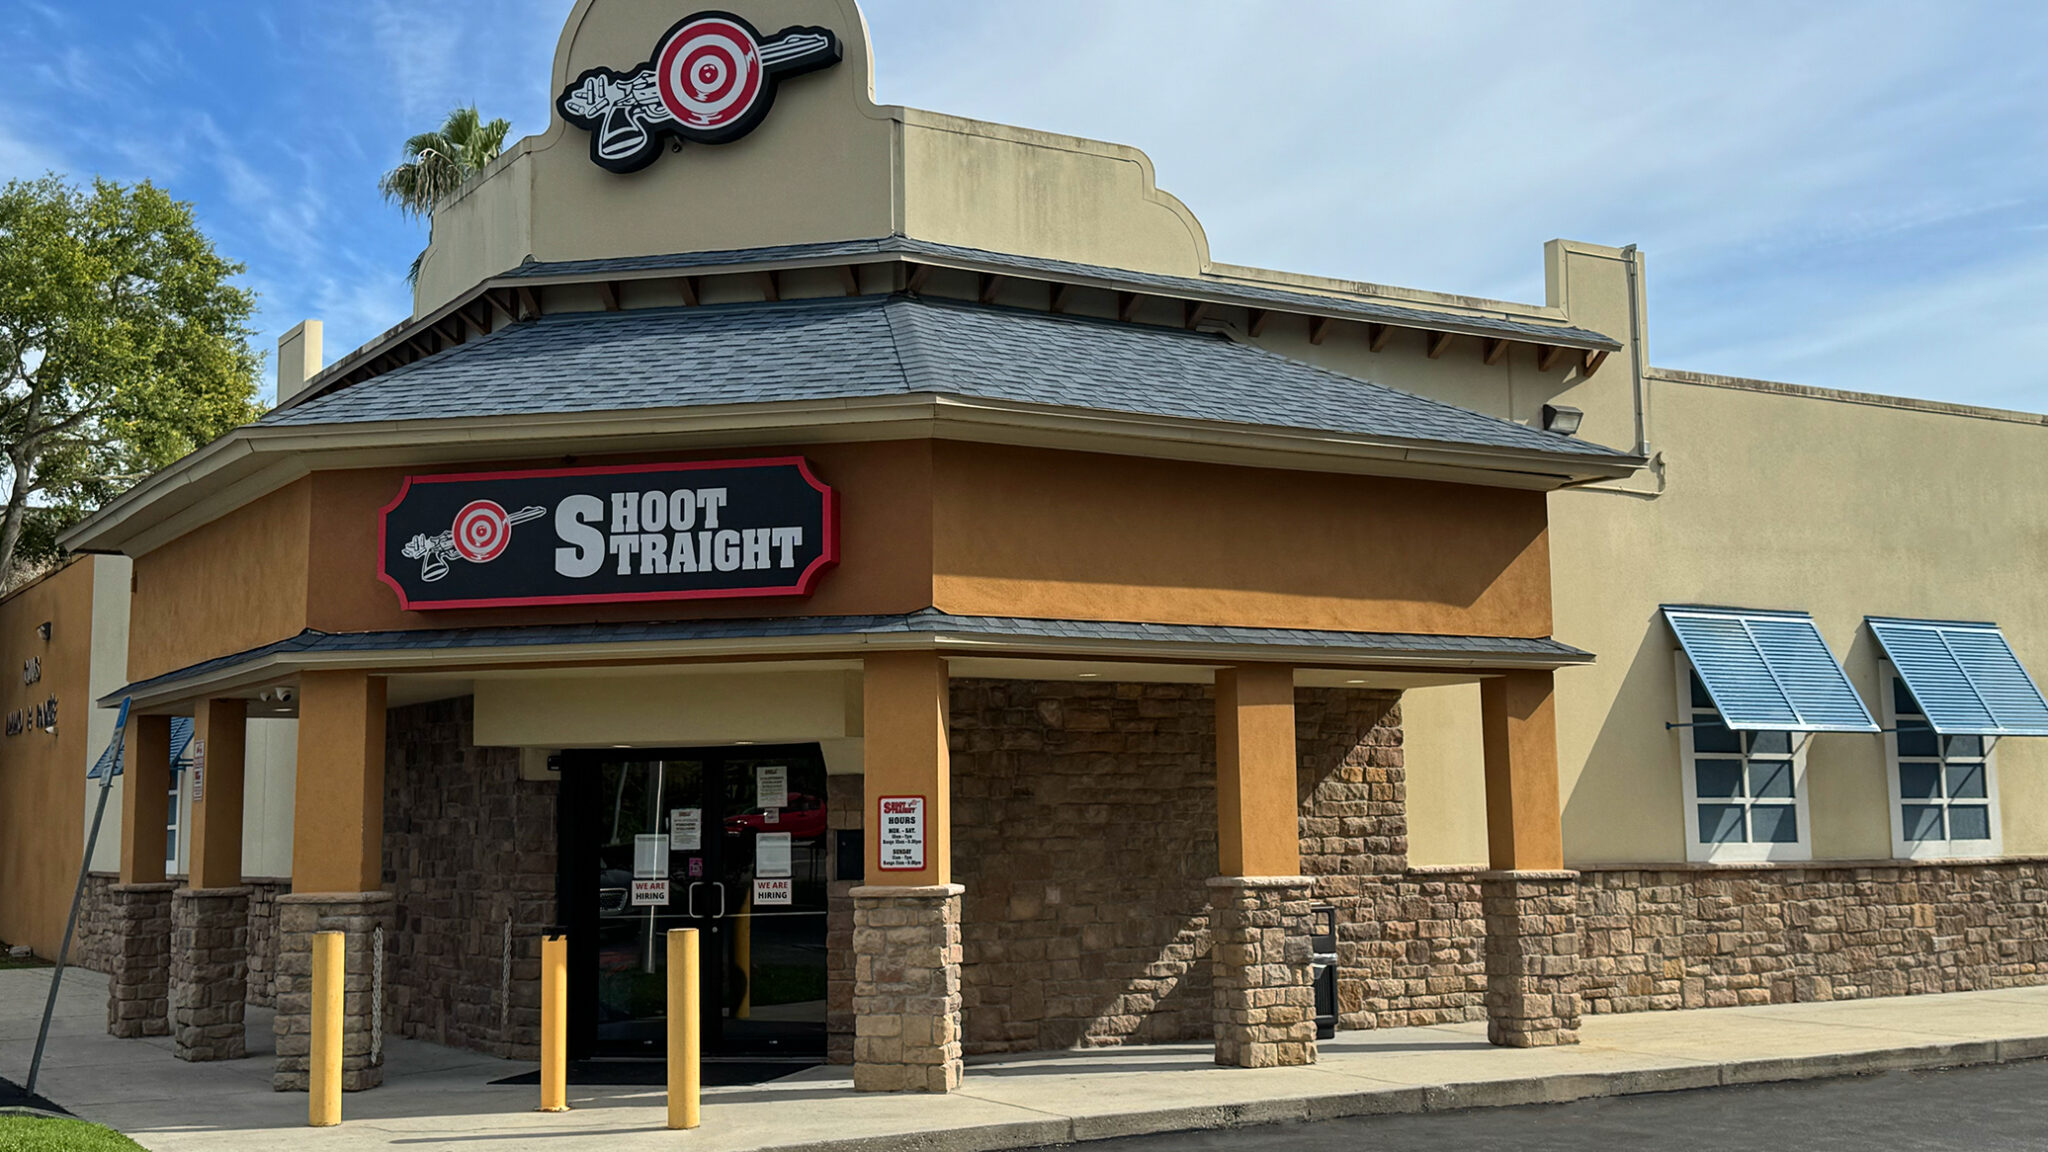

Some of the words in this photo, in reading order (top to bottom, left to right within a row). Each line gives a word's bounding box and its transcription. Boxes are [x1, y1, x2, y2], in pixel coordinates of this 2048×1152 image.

[554, 487, 727, 578] SHOOT
[888, 816, 916, 824] HOURS
[635, 882, 648, 890] WE
[650, 882, 665, 890] ARE
[757, 881, 770, 889] WE
[772, 881, 788, 889] ARE
[635, 892, 665, 900] HIRING
[758, 891, 788, 899] HIRING
